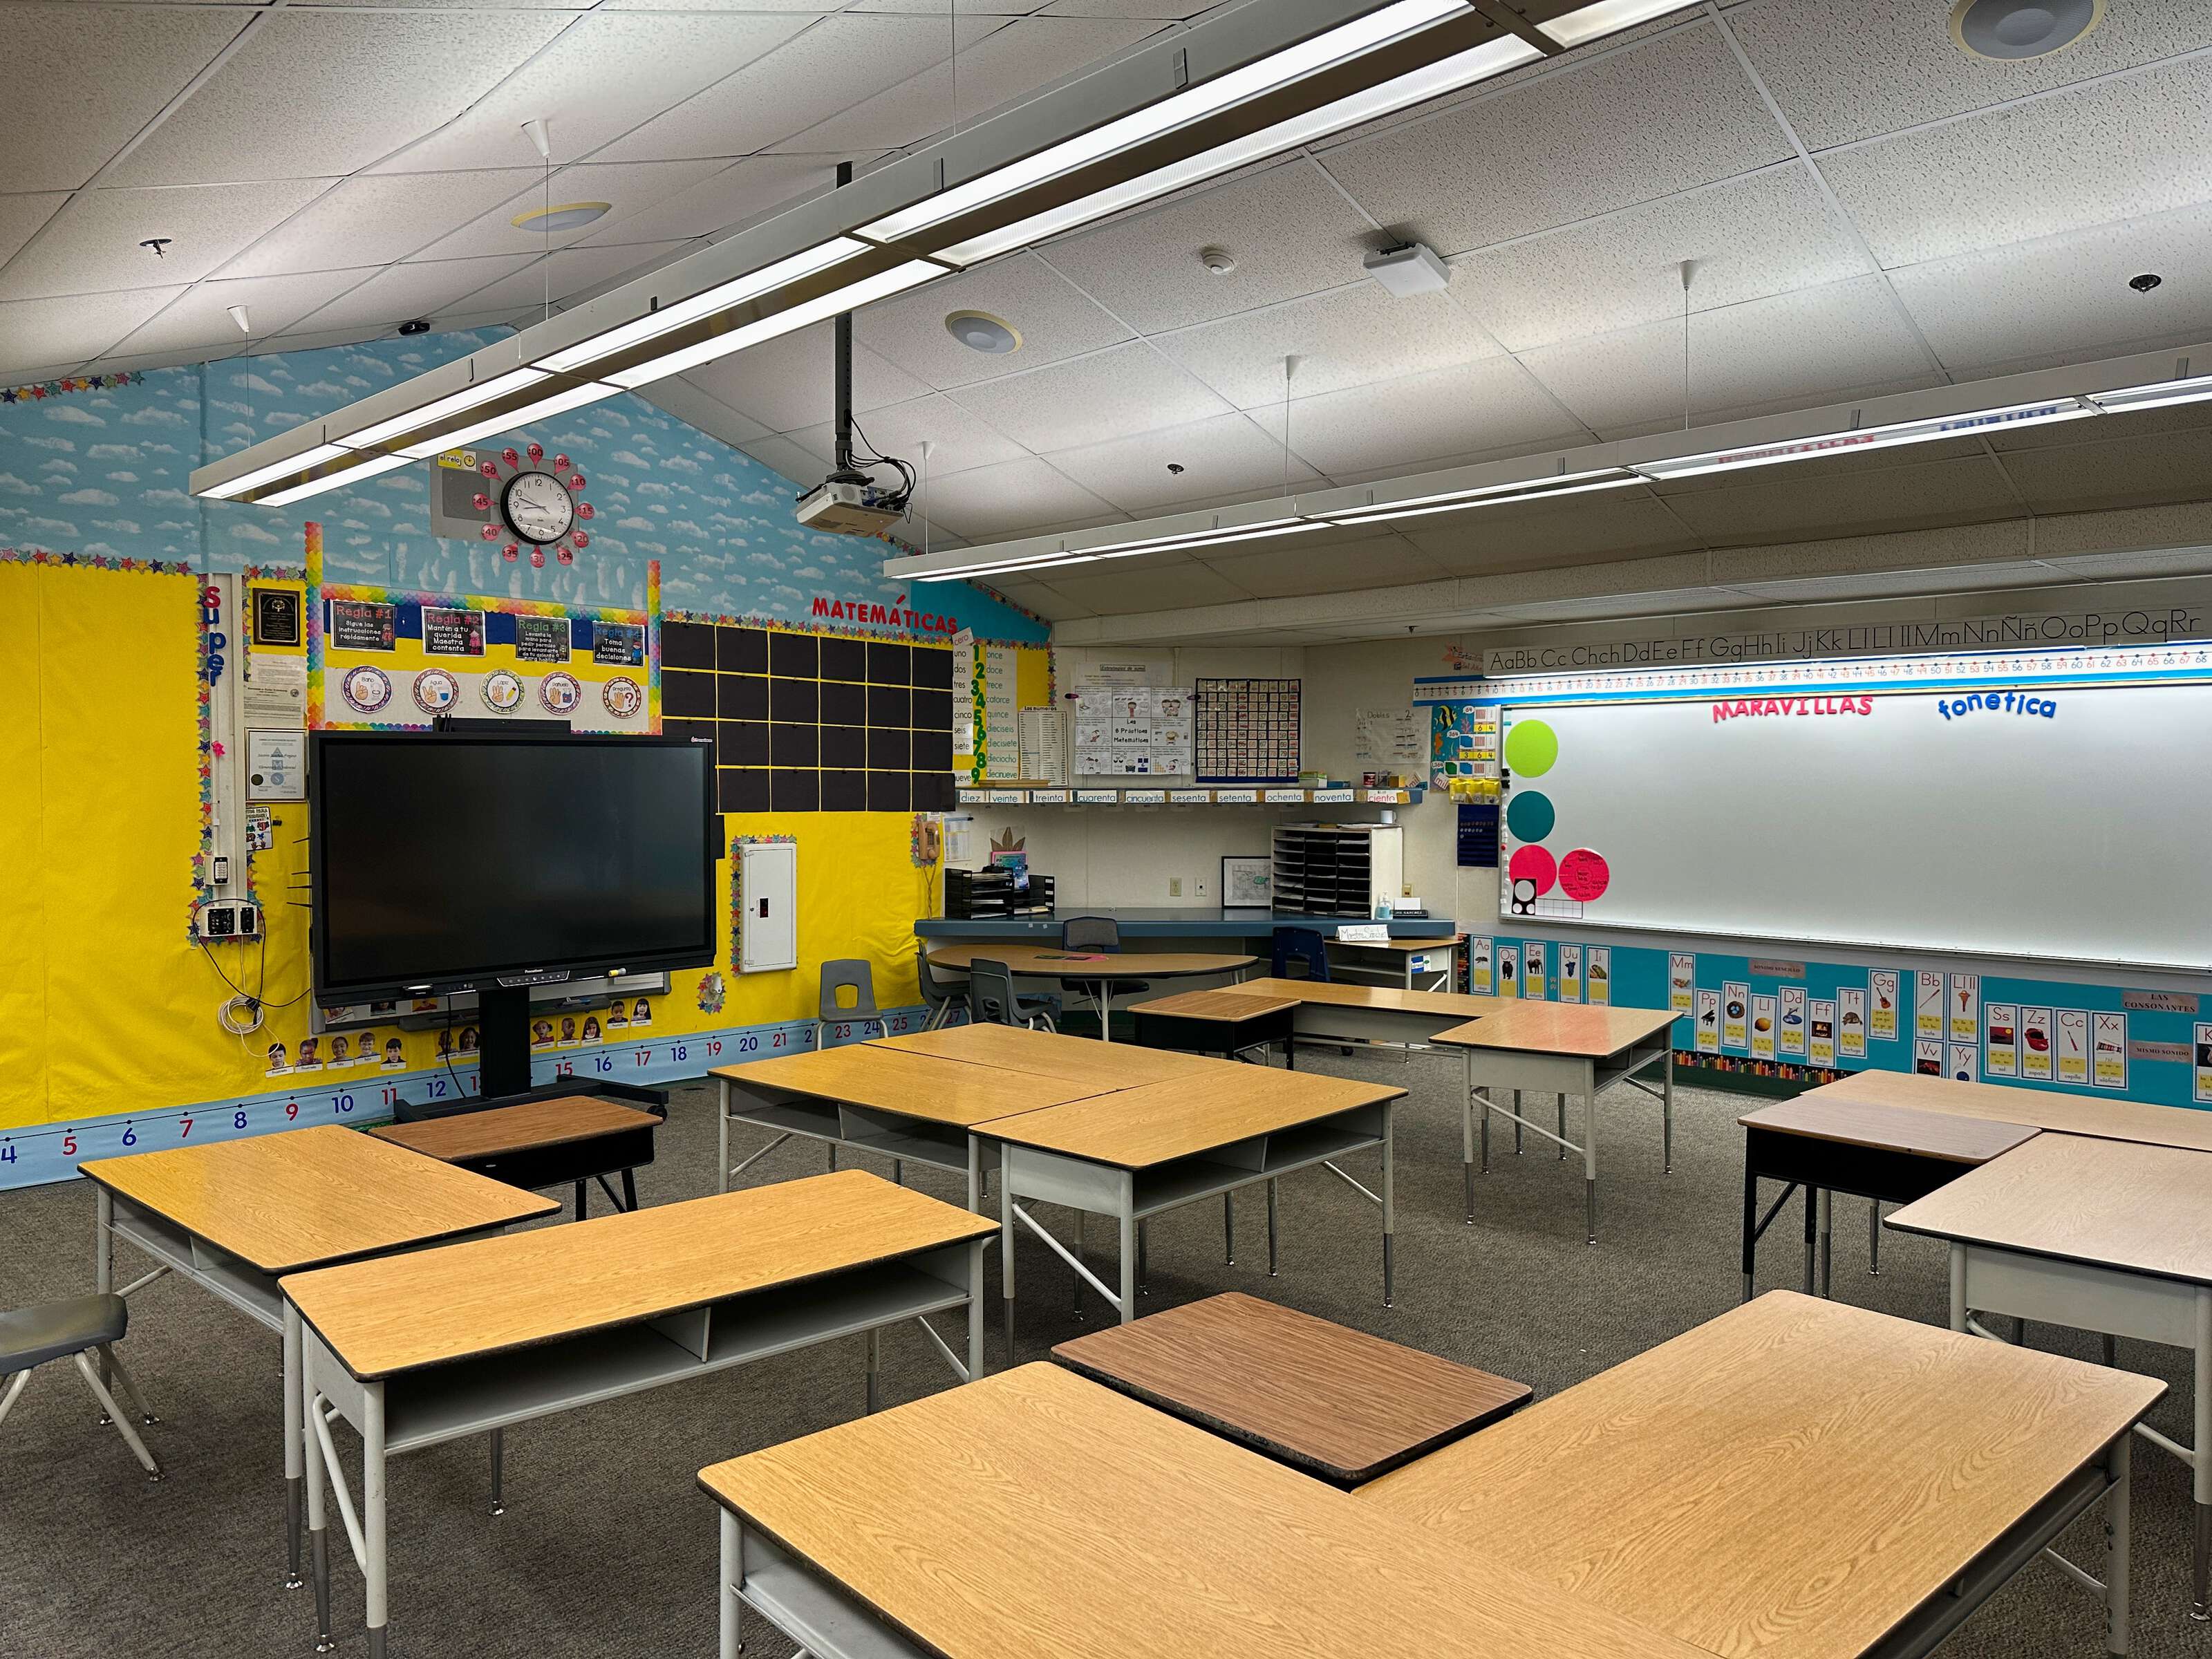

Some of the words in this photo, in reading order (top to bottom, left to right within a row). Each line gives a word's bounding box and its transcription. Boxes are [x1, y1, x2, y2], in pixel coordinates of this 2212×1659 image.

[447, 456, 462, 466] reloj
[336, 606, 371, 618] Regla
[375, 608, 391, 619] #1
[427, 613, 460, 624] Regla
[464, 615, 480, 625] #2
[812, 594, 957, 635] MATEMÁTICAS
[518, 619, 548, 632] Regla
[552, 624, 565, 632] #3
[595, 626, 622, 638] Regla
[954, 634, 968, 646] cero
[973, 645, 979, 662] 1
[986, 651, 1002, 659] once
[2132, 657, 2143, 665] 64
[2180, 655, 2190, 664] 67
[2195, 655, 2207, 664] 68
[954, 664, 966, 673] dos
[975, 662, 985, 679] 2
[986, 665, 1002, 674] doce
[971, 679, 980, 695] 3
[986, 681, 1002, 689] trece
[953, 695, 973, 704] cuatro
[975, 693, 986, 709] 4
[986, 695, 1010, 704] catorce
[1938, 692, 2056, 720] fonetica
[1712, 695, 1873, 722] MARAVILLAS
[954, 711, 972, 719] cinco
[973, 709, 982, 726] 5
[987, 711, 1009, 721] quince
[977, 725, 986, 740] 6
[973, 740, 982, 756] 7
[976, 752, 986, 769] 8
[988, 755, 1017, 763] dieciocho
[971, 767, 980, 784] 9
[986, 769, 1017, 778] diecinueve
[1409, 774, 1420, 787] mil
[1436, 777, 1449, 789] mil
[961, 793, 980, 802] diez
[992, 794, 1018, 803] veinte
[1035, 793, 1063, 802] treinta
[1078, 793, 1116, 802] cuarenta
[1126, 794, 1164, 802] cincuenta
[1172, 794, 1206, 802] sesenta
[1219, 794, 1251, 802] setenta
[1266, 793, 1302, 802] ochenta
[1315, 793, 1351, 802] noventa
[1368, 794, 1395, 803] ciento
[1476, 939, 1489, 950] Aa
[1501, 950, 1516, 961] Oo
[1529, 946, 1541, 957] Ee
[1564, 948, 1578, 959] Uu
[1671, 957, 1693, 968] Mm
[1873, 973, 1894, 993] Gg
[1922, 973, 1940, 986] Bb
[1728, 985, 1745, 998] Nn
[1784, 991, 1802, 1004] Dd
[1846, 991, 1859, 1004] Tt
[1702, 993, 1716, 1009] Pp
[2125, 1001, 2195, 1013] CONSONANTES
[1815, 1003, 1831, 1016] Ff
[1993, 1006, 2010, 1022] Ss
[2027, 1010, 2045, 1024] Zz
[2061, 1013, 2083, 1028] Cc
[2099, 1015, 2119, 1031] Xx
[2137, 1047, 2159, 1055] MISMO
[2162, 1048, 2189, 1056] SONIDO
[1, 1145, 17, 1164] 4
[63, 1136, 77, 1156] 5
[122, 1127, 137, 1147] 6
[180, 1119, 194, 1138] 7
[234, 1111, 248, 1130] 8
[285, 1103, 299, 1121] 9
[332, 1095, 354, 1114] 10
[427, 1080, 447, 1098] 12
[595, 1056, 612, 1073] 16
[635, 1051, 651, 1067] 17
[671, 1046, 687, 1062] 18
[706, 1041, 722, 1057] 19
[740, 1036, 758, 1052] 20
[773, 1033, 787, 1048] 21
[835, 1024, 851, 1039] 23
[892, 1016, 908, 1031] 25
